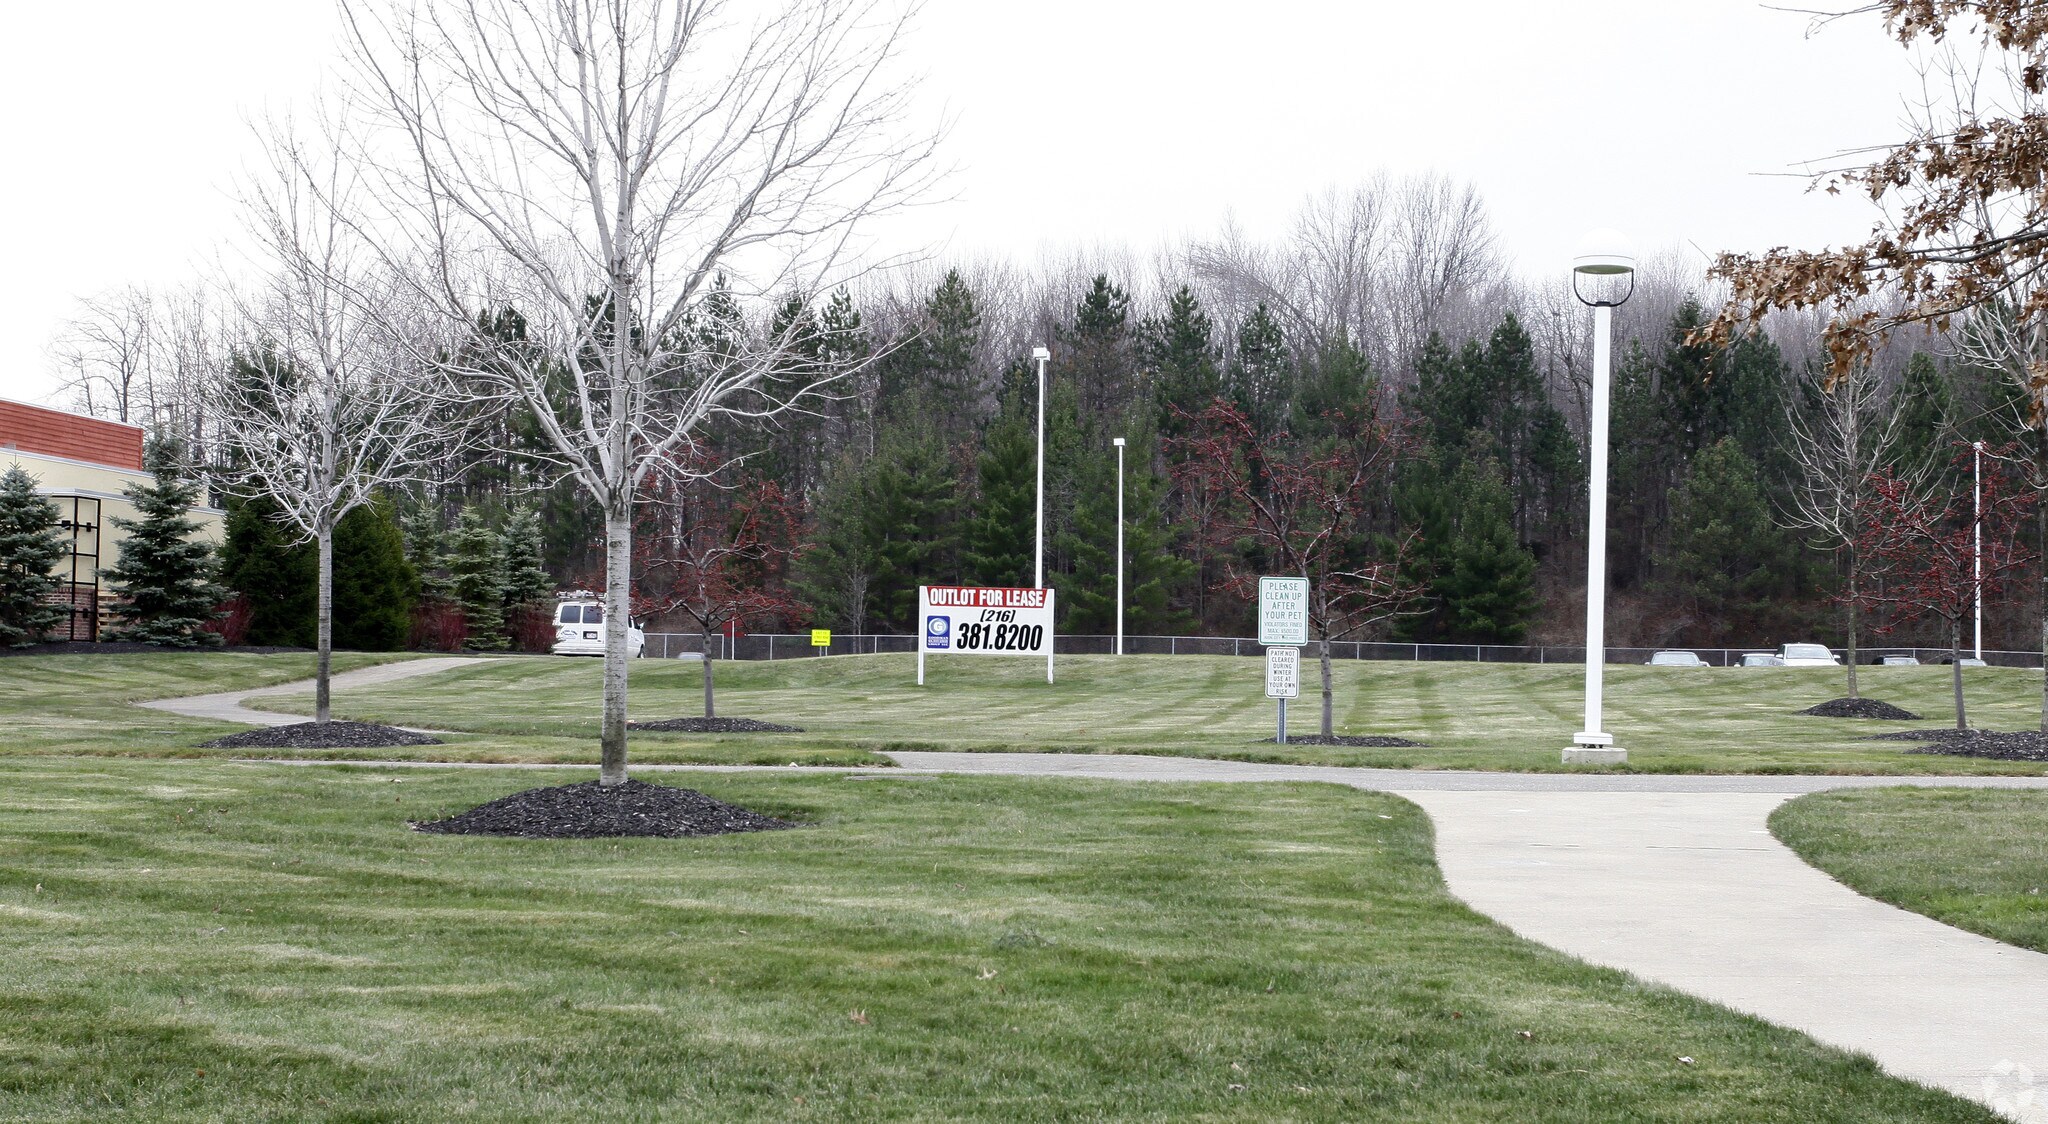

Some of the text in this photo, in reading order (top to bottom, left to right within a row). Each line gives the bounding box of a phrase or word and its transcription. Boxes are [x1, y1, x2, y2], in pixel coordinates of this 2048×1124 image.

[1270, 582, 1298, 591] PLEASE
[930, 588, 1043, 607] OUTLOT FOR LEASE
[1265, 592, 1302, 600] CLEAN UP
[1272, 602, 1295, 610] AFTER
[980, 609, 1016, 623] (216)
[1265, 611, 1302, 619] YOUR PET
[957, 622, 1043, 651] 381.8200
